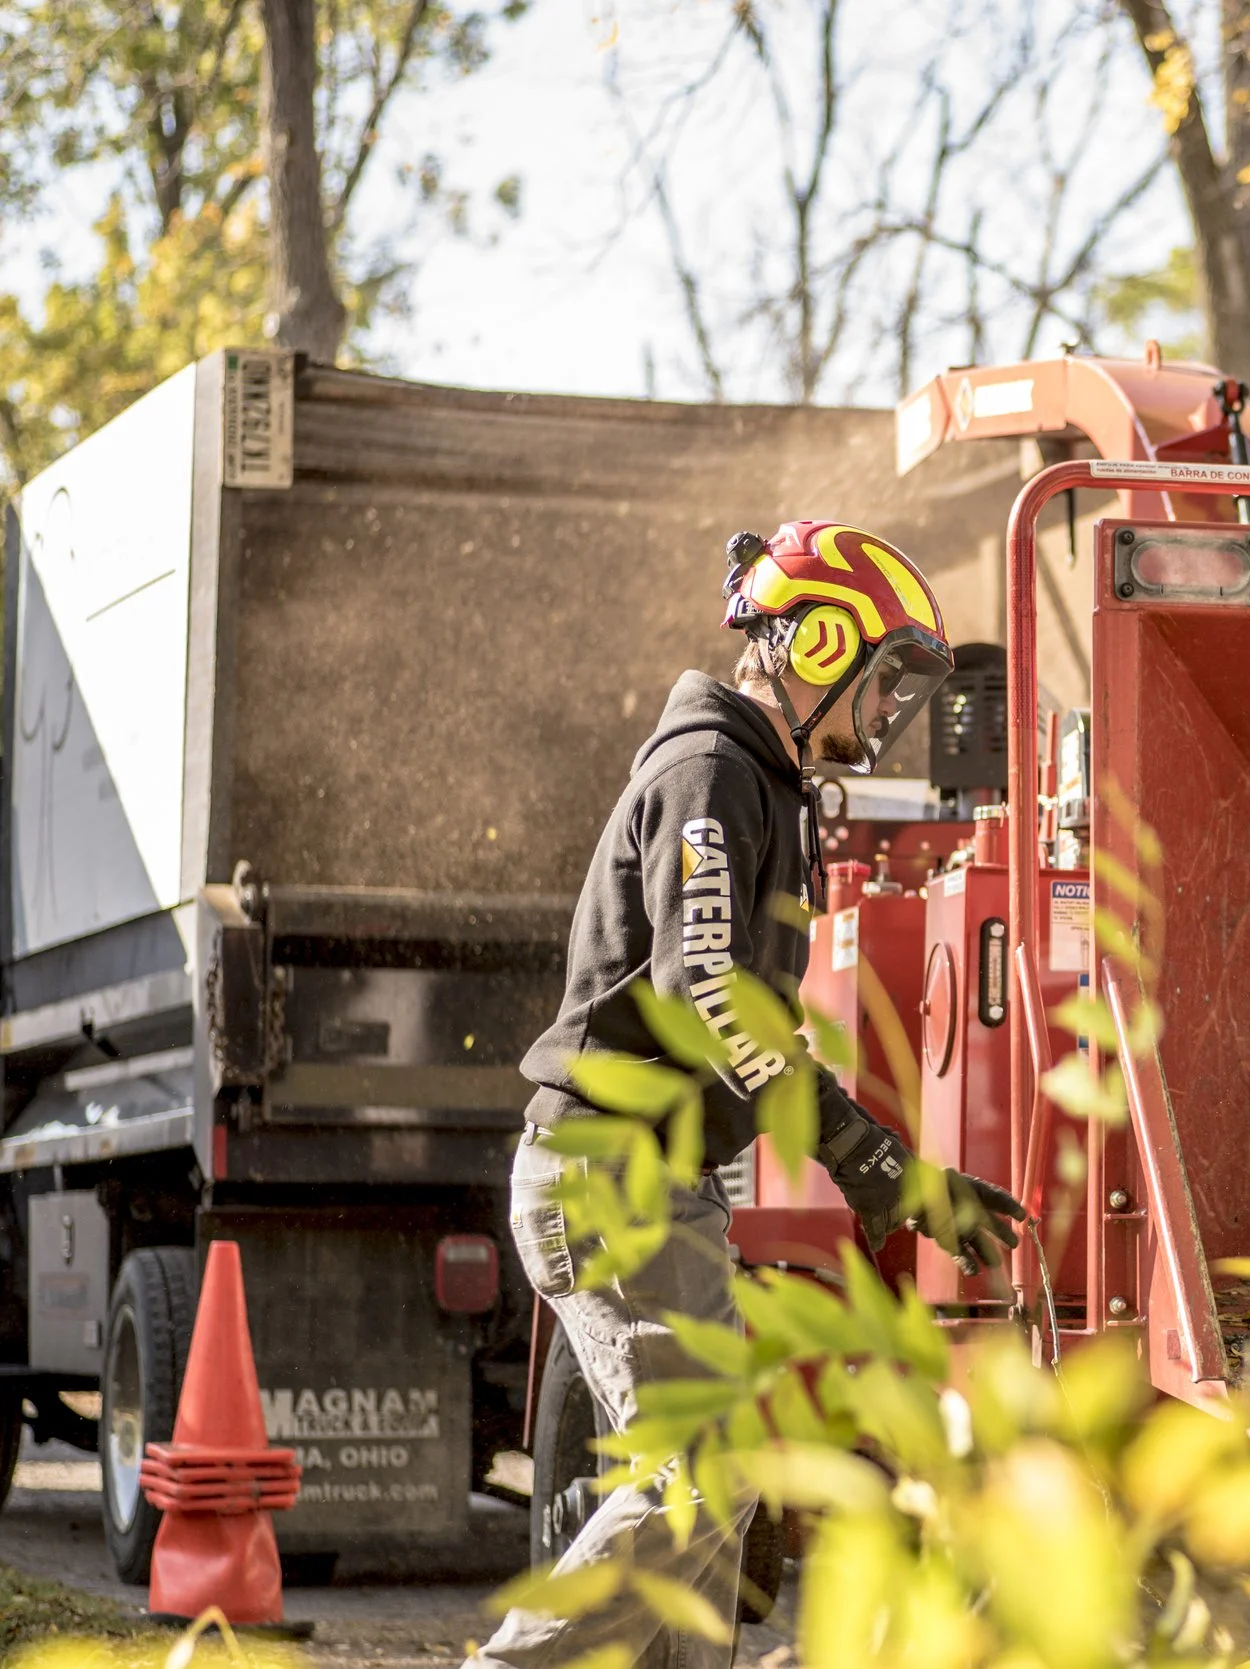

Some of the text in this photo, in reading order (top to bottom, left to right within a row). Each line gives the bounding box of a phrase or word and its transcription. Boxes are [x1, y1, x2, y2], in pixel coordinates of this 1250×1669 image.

[1170, 468, 1207, 479] BARRA
[1210, 470, 1224, 479] DE
[1054, 884, 1089, 897] NOTI
[860, 1138, 892, 1174] BECK'S
[340, 1445, 409, 1468] OHIO
[298, 1481, 439, 1501] mtruck.com
